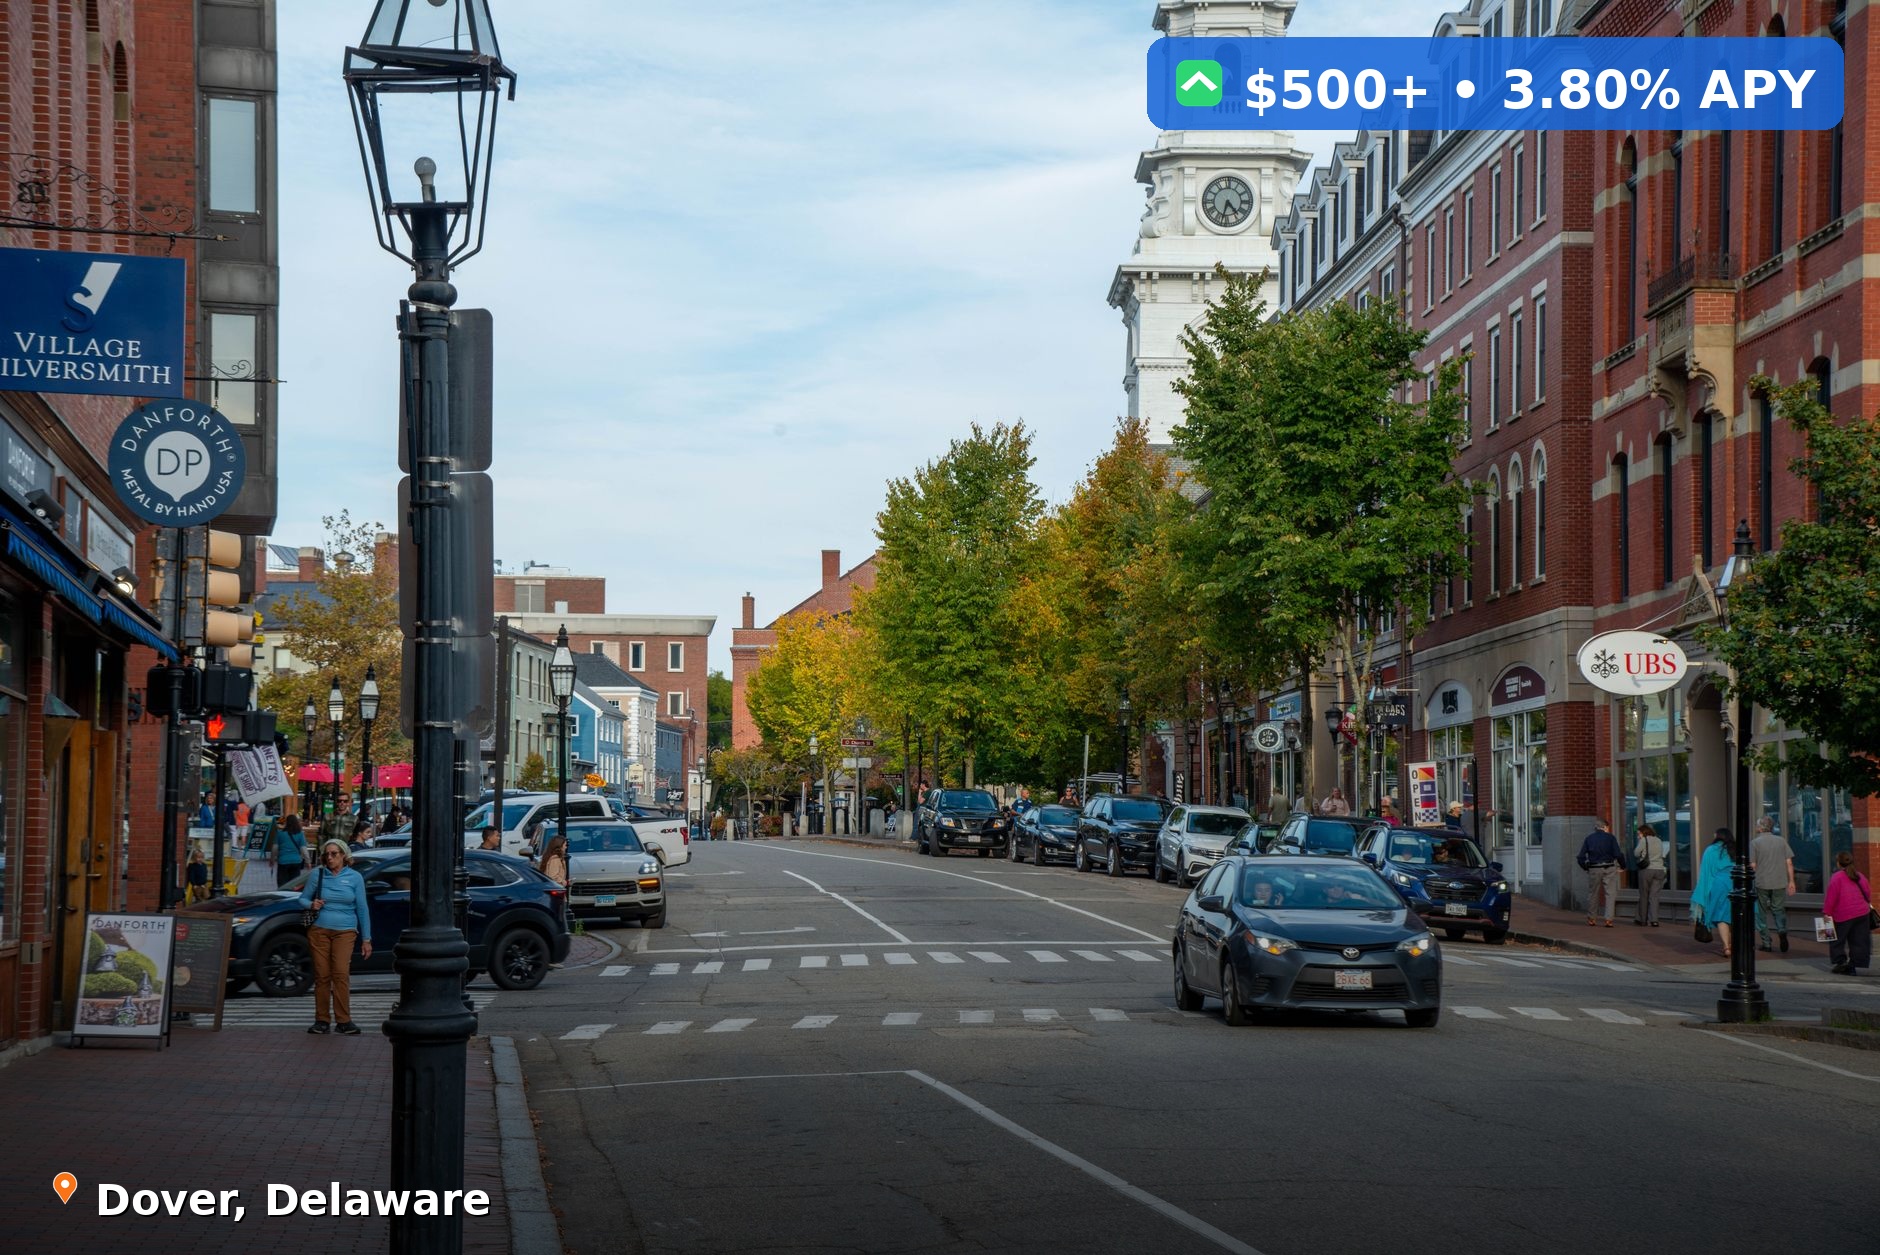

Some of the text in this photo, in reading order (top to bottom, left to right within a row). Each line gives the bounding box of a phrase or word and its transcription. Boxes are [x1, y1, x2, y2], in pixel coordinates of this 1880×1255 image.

[13, 331, 142, 359] VILLAGE
[0, 357, 171, 385] ILVERSMITH
[121, 407, 233, 453] DANFORTH
[157, 448, 203, 477] DP
[121, 468, 234, 517] METAL BY HAND USA
[1623, 652, 1677, 675] UBS
[95, 918, 166, 930] DANFORTH
